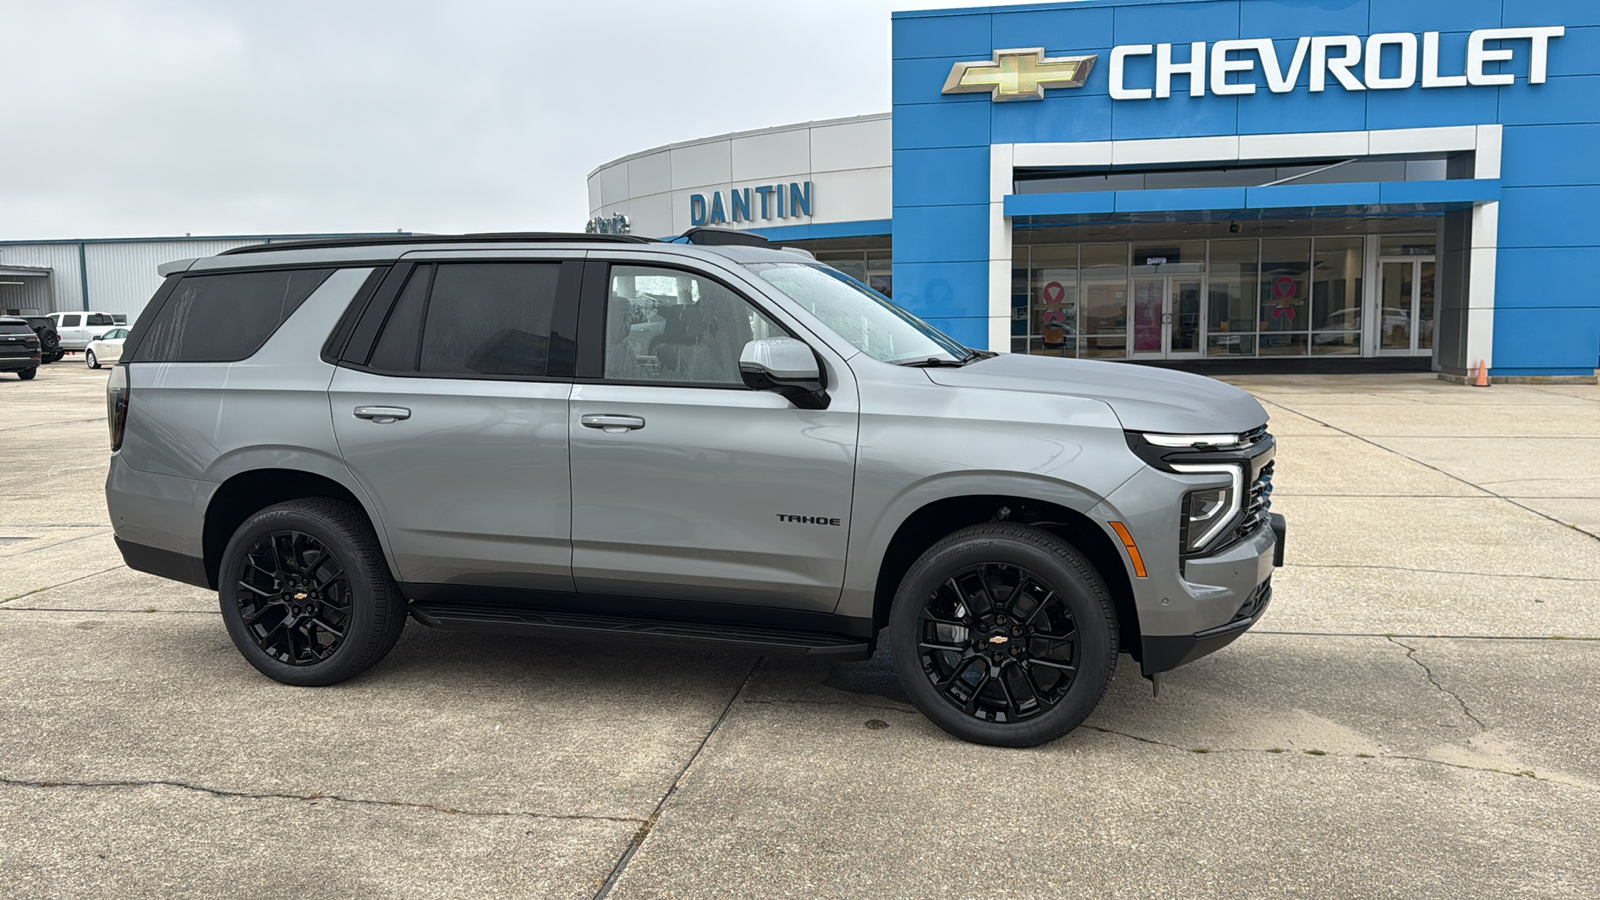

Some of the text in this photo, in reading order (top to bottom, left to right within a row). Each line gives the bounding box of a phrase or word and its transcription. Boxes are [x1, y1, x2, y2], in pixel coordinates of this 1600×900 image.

[1109, 25, 1566, 100] CHEVROLET
[690, 181, 812, 227] DANTIN
[776, 513, 841, 527] TAHOE
